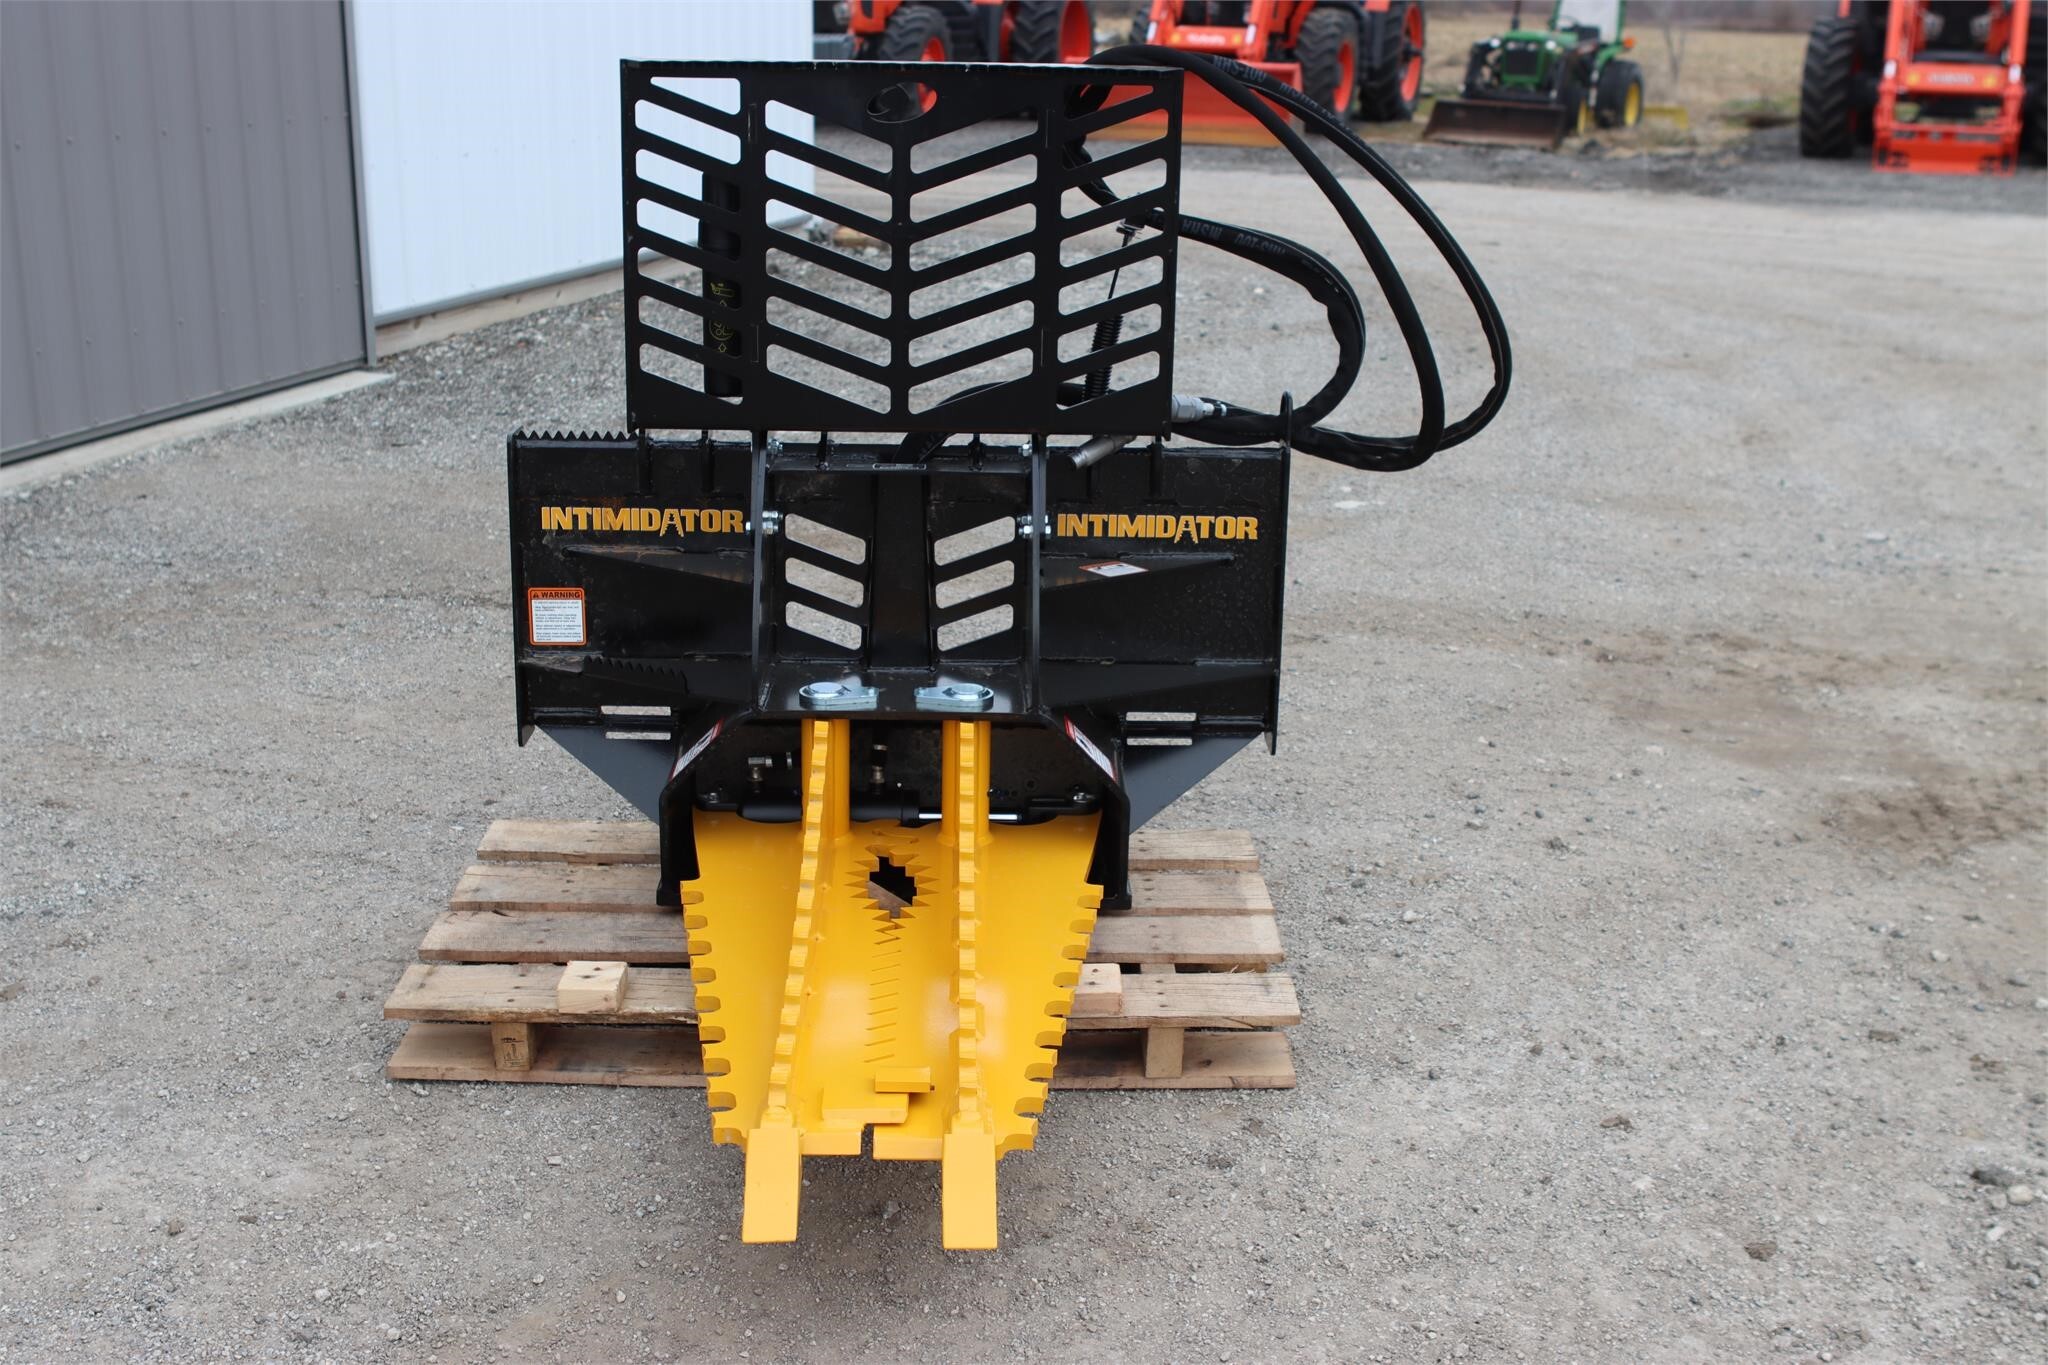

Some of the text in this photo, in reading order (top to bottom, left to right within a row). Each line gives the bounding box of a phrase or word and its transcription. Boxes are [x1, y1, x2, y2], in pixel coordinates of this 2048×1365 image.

[541, 506, 744, 537] INTIMIDATOR
[1057, 513, 1258, 544] INTIMIDATOR
[541, 591, 581, 599] WARNING
